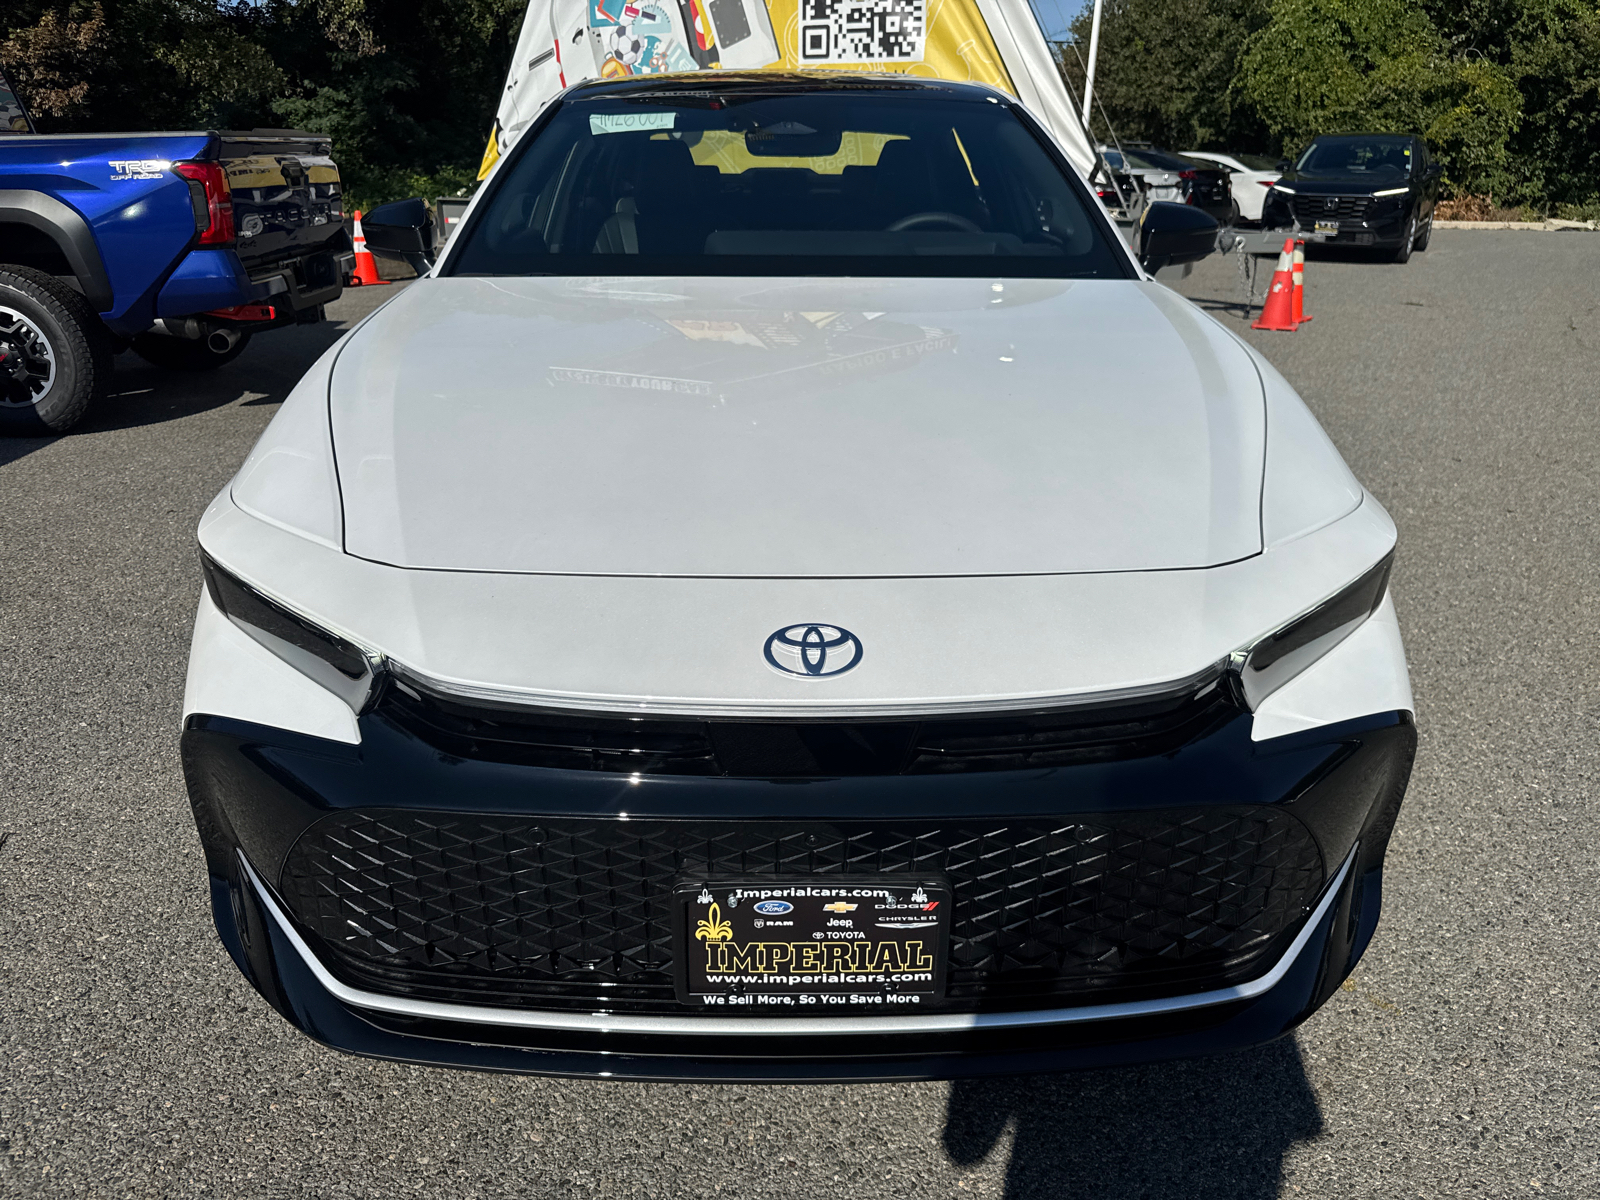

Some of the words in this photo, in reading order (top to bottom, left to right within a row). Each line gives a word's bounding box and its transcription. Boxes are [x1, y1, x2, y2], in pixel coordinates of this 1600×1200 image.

[108, 160, 162, 175] TRD
[735, 888, 890, 900] Imperialcars.com
[762, 902, 785, 912] Ford
[826, 918, 853, 928] Jeep
[705, 941, 933, 973] IMPERIAL
[705, 972, 933, 985] www.imperialcars.com
[703, 995, 725, 1004] We
[728, 995, 753, 1005] Sell
[757, 995, 795, 1006] More,
[799, 995, 817, 1004] So
[820, 994, 846, 1004] You
[849, 994, 882, 1004] Save
[886, 993, 920, 1004] More
